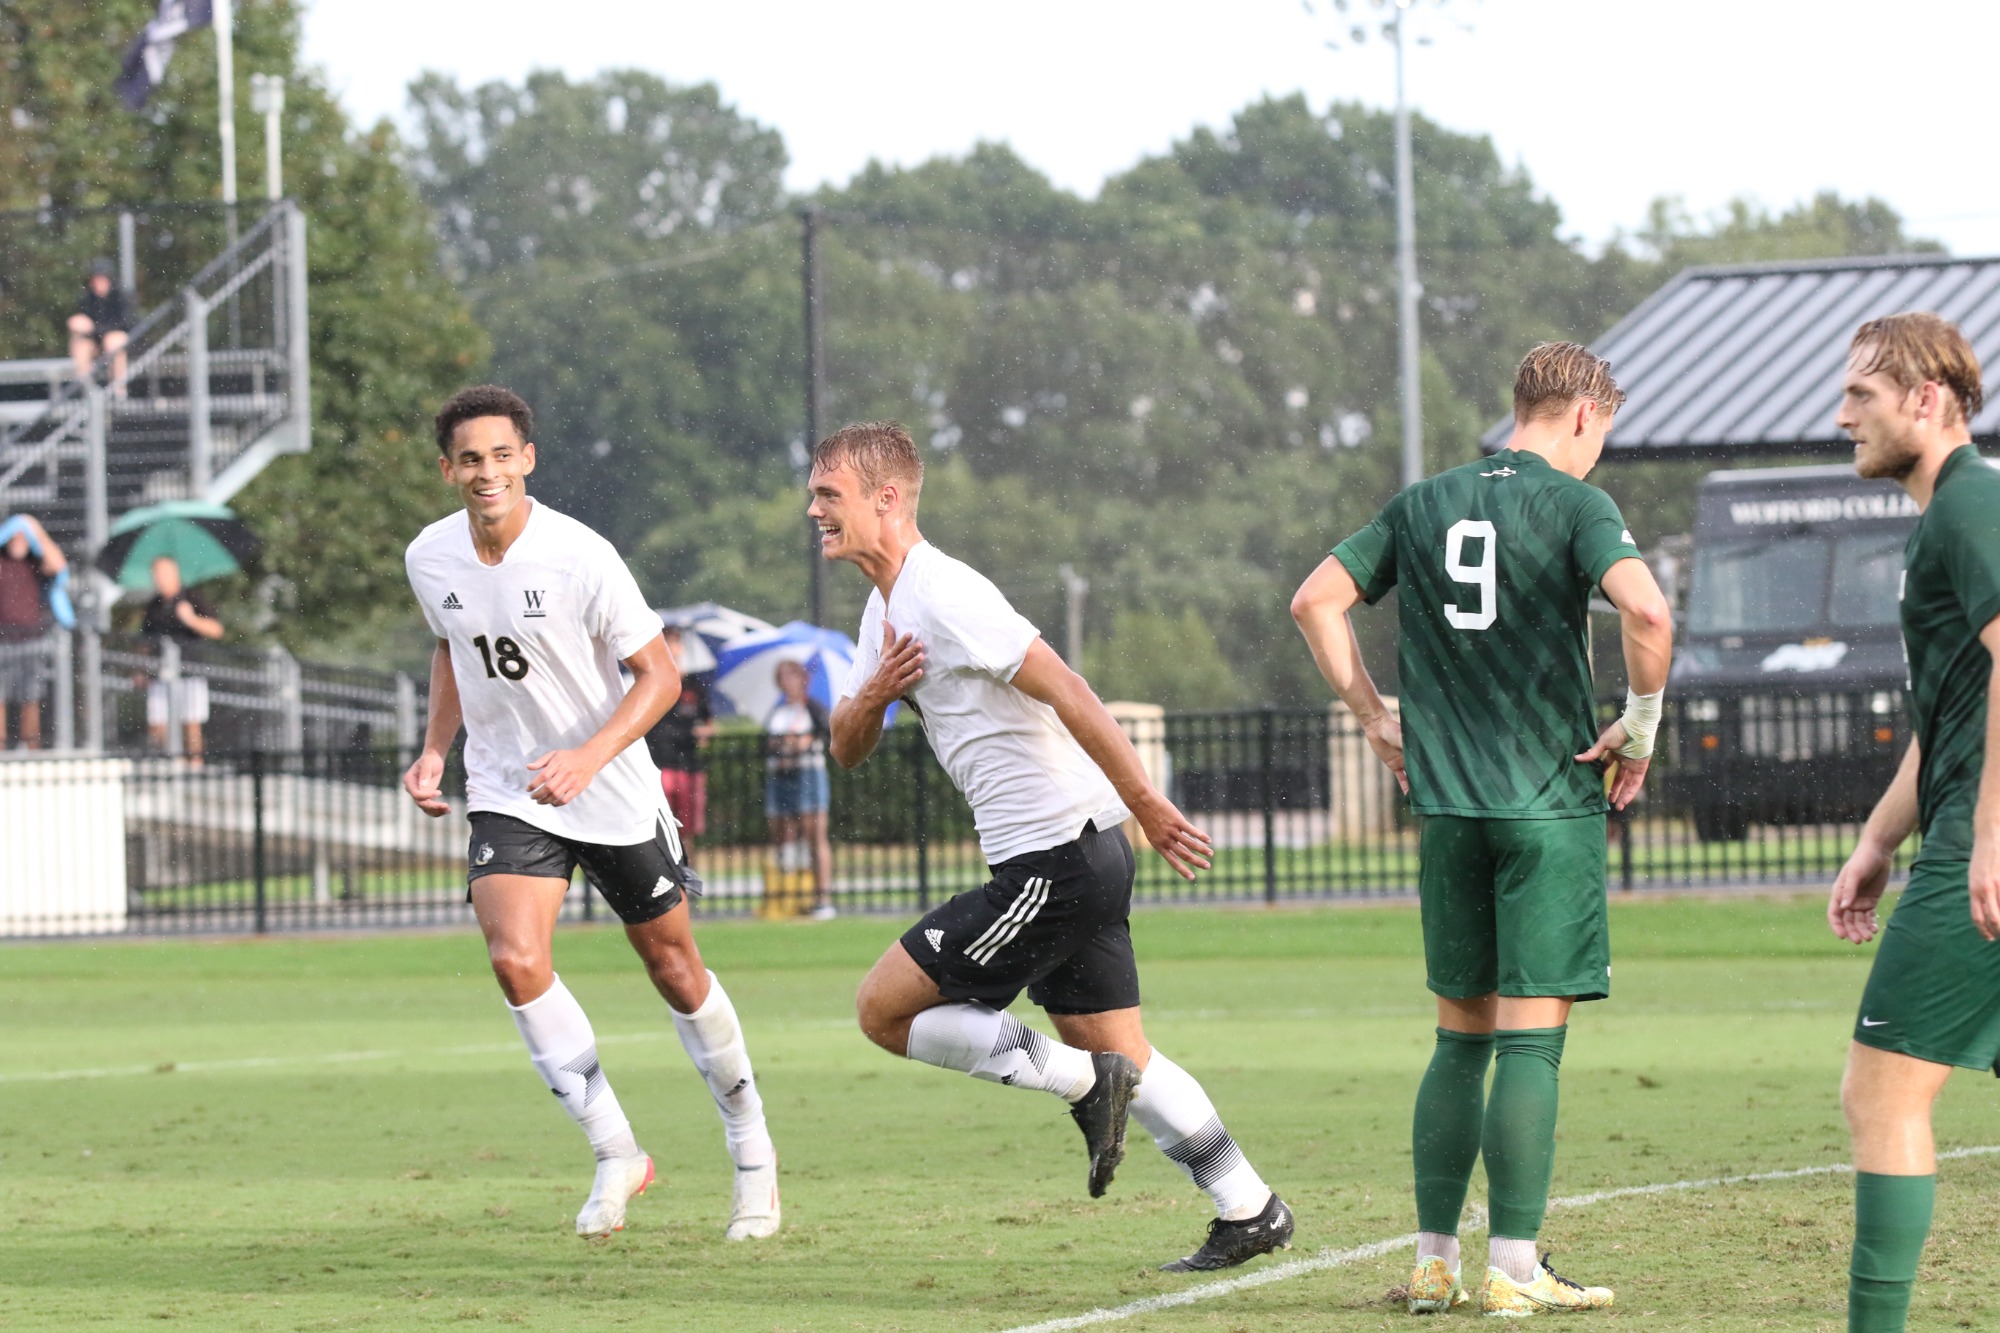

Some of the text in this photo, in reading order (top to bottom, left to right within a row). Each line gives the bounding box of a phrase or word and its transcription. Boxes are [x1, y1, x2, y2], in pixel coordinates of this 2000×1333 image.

[1730, 497, 1842, 525] WOFFORD
[1444, 519, 1497, 630] 9
[523, 590, 546, 609] W
[473, 634, 529, 681] 18
